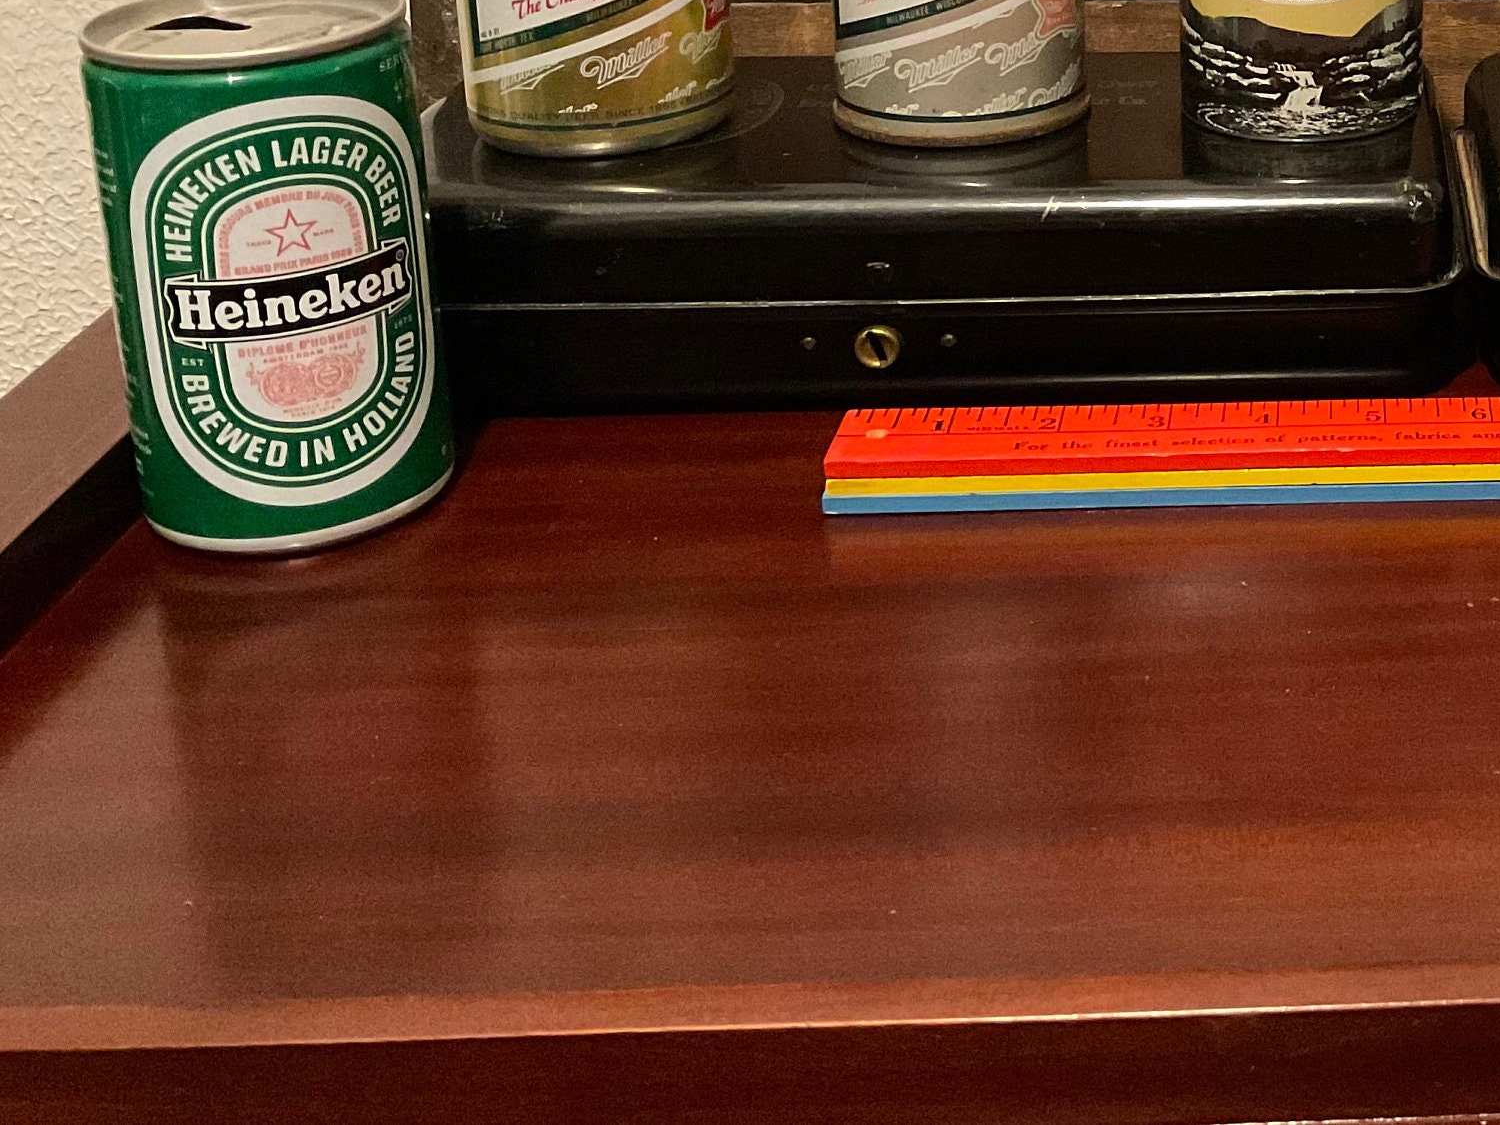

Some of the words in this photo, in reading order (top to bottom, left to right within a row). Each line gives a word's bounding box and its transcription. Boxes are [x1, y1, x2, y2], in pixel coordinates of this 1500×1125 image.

[511, 0, 542, 19] The
[886, 6, 930, 25] MILWAUKEE
[580, 31, 673, 90] Miller
[894, 41, 985, 93] Miller
[164, 145, 263, 263] HEINEKEN
[270, 135, 369, 173] LAGER
[364, 155, 403, 228] BEER
[253, 190, 304, 211] MEMBRE
[306, 190, 321, 201] DU
[234, 264, 272, 277] GRAND
[273, 260, 300, 272] PRIX
[299, 252, 330, 267] PARIS
[174, 263, 407, 331] Heineken
[181, 357, 205, 368] EST
[237, 342, 295, 359] DIPLOME
[262, 347, 325, 365] AMSTERDAM
[181, 374, 289, 469] BREWED
[300, 435, 337, 469] IN
[341, 331, 415, 454] HOLLAND
[932, 419, 944, 433] 1
[1038, 417, 1058, 431] 2
[1148, 415, 1166, 429] 3
[1254, 412, 1270, 426] 4
[1364, 410, 1383, 424] 5
[1470, 407, 1488, 422] 6
[1013, 439, 1049, 452] For
[1062, 439, 1093, 450] the
[1105, 437, 1159, 450] finest
[1171, 435, 1256, 448] selection
[1264, 433, 1285, 444] of
[1297, 430, 1384, 444] patterns,
[1394, 429, 1463, 442] fabrics
